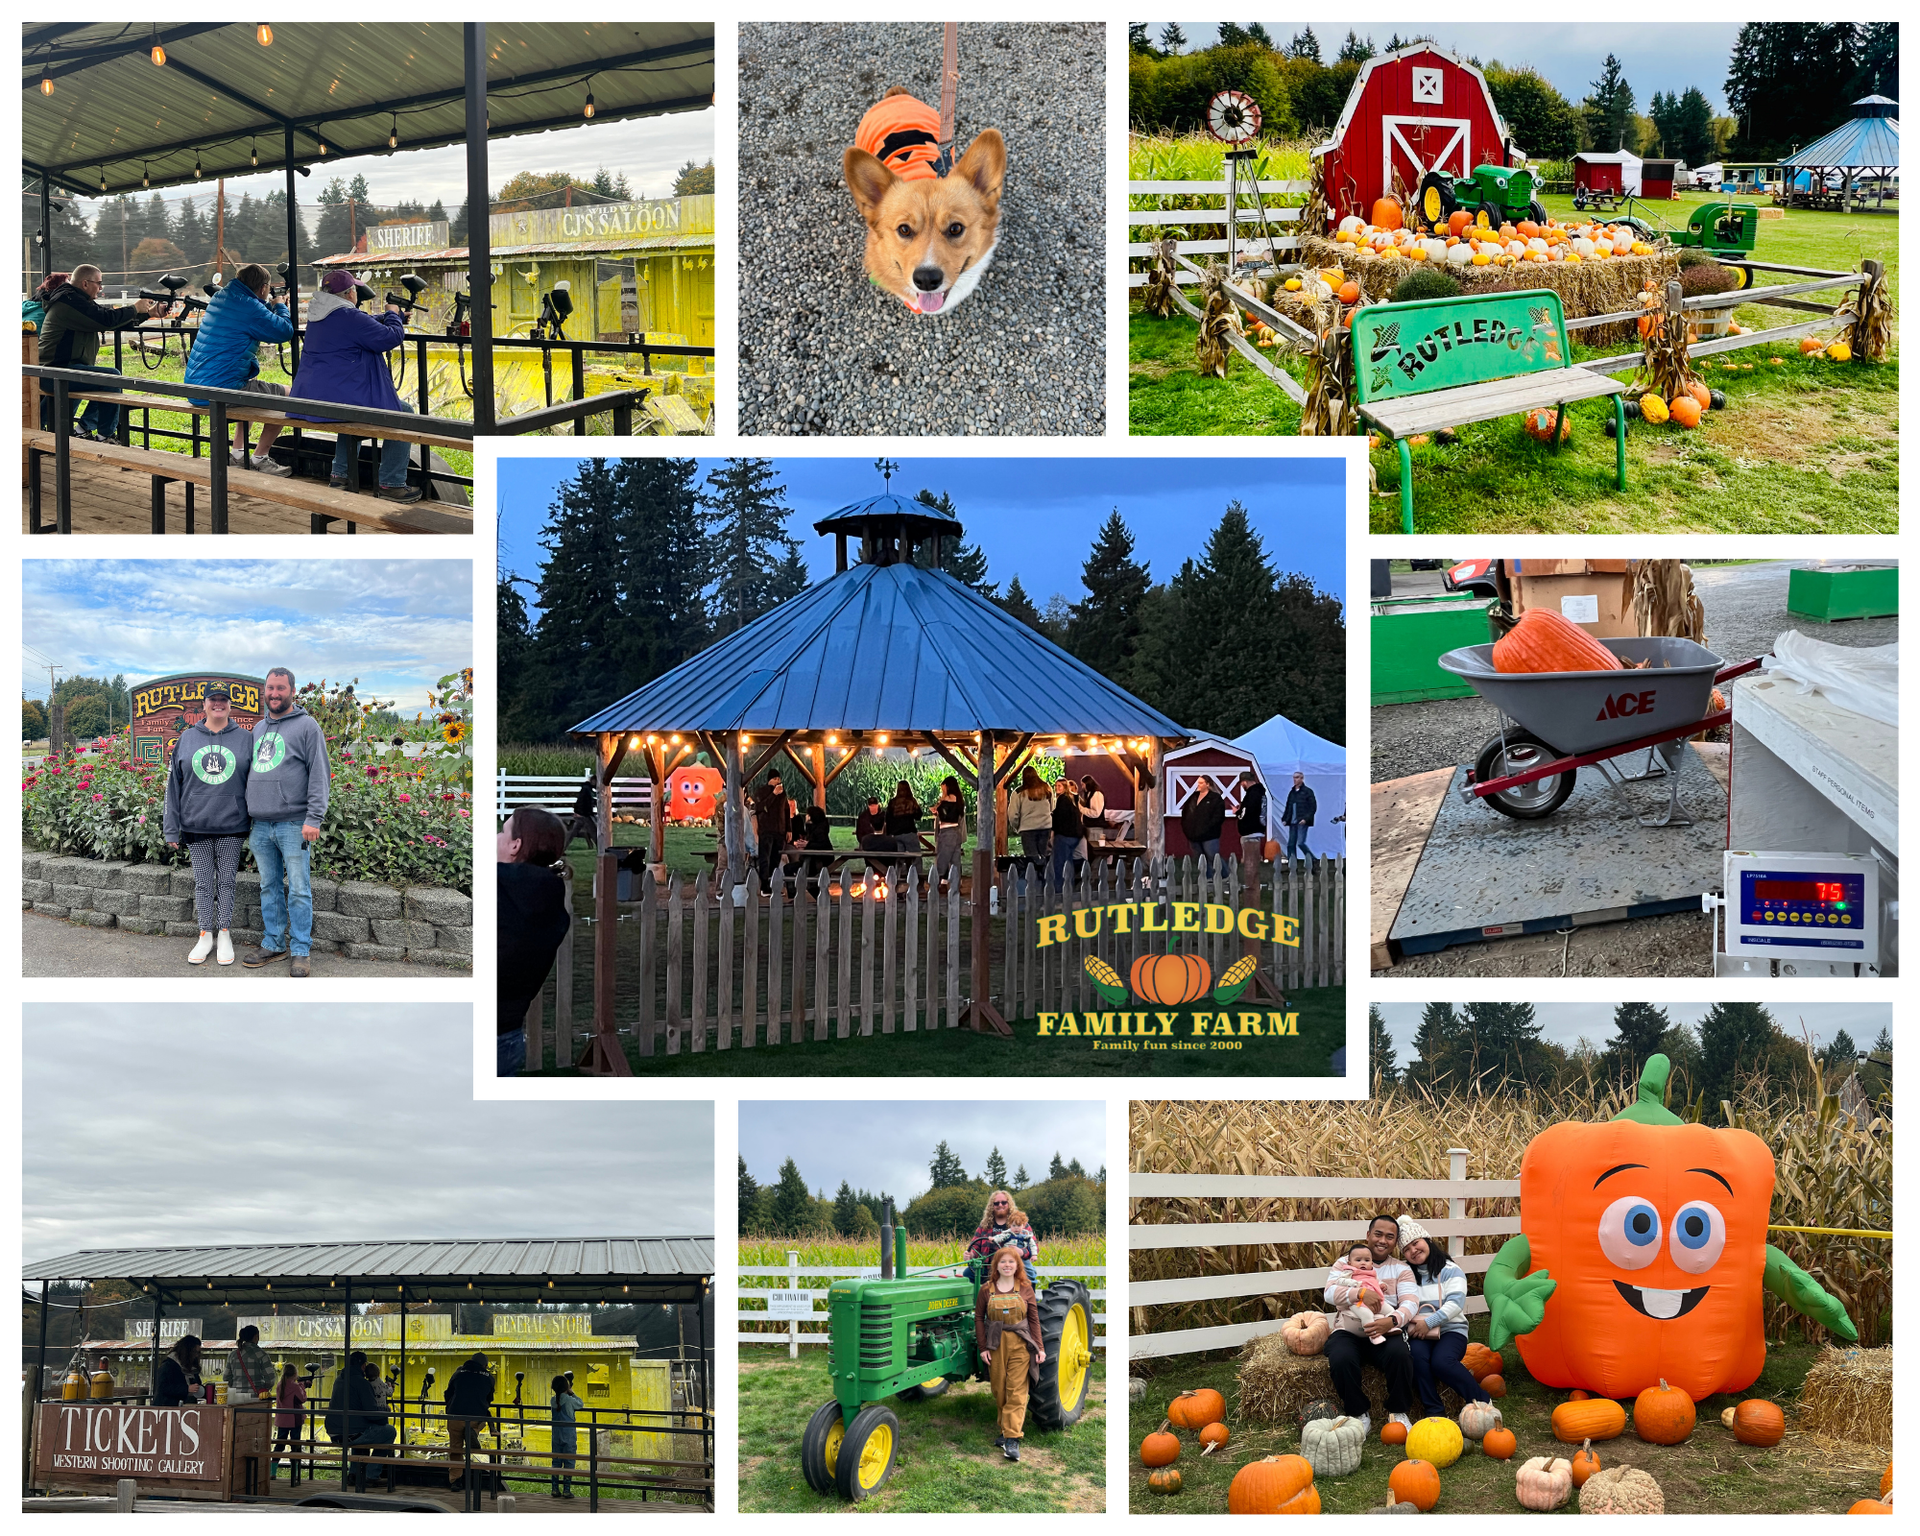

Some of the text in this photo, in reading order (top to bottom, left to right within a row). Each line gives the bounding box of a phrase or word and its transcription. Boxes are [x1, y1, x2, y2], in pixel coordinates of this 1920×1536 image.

[563, 201, 680, 237] CJ'S SALOON
[589, 203, 652, 214] WILD WEST
[377, 224, 434, 248] SHERIFF
[1397, 319, 1540, 381] RUTLEDGE
[136, 682, 260, 718] RUTLEGE
[1595, 690, 1656, 721] ACE
[1811, 765, 1875, 819] STAFF PERSONAL ITEMS
[1816, 882, 1842, 900] 75
[928, 1299, 943, 1310] JOHN
[298, 1317, 383, 1338] CJ'S SAOON
[494, 1314, 591, 1334] GENERAL STORE
[60, 1407, 201, 1456] TICKETS
[53, 1454, 205, 1474] WESTERN SHOOTING GALLERY
